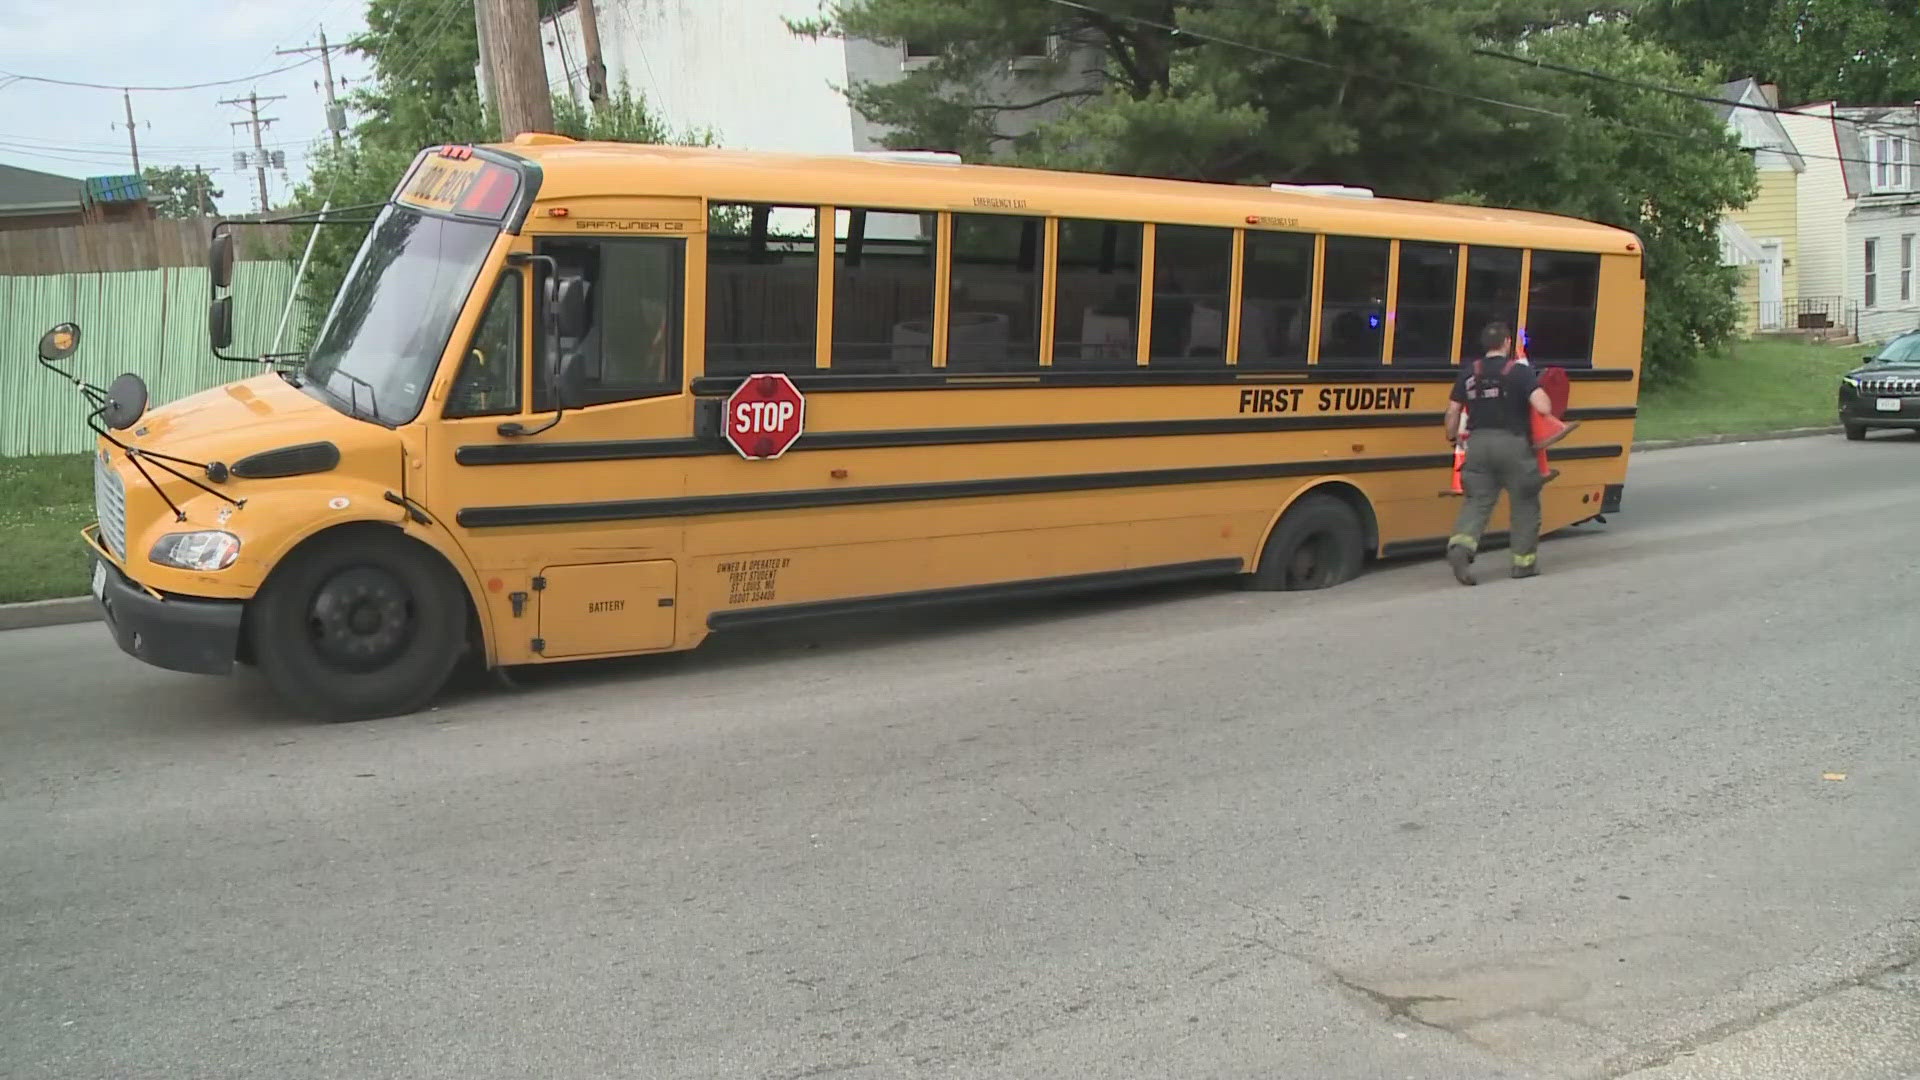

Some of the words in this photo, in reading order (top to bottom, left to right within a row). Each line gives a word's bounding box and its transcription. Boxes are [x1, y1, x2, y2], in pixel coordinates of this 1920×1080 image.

[1013, 199, 1027, 208] EXIT
[664, 222, 683, 230] C2
[1239, 389, 1304, 413] FIRST
[1318, 387, 1415, 411] STUDENT
[736, 401, 794, 433] STOP
[717, 562, 740, 573] OWNED
[749, 559, 780, 571] OPERATED
[781, 558, 790, 568] BY
[729, 572, 747, 583] FIRST
[749, 569, 777, 581] STUDENT
[589, 600, 625, 613] BATTERY
